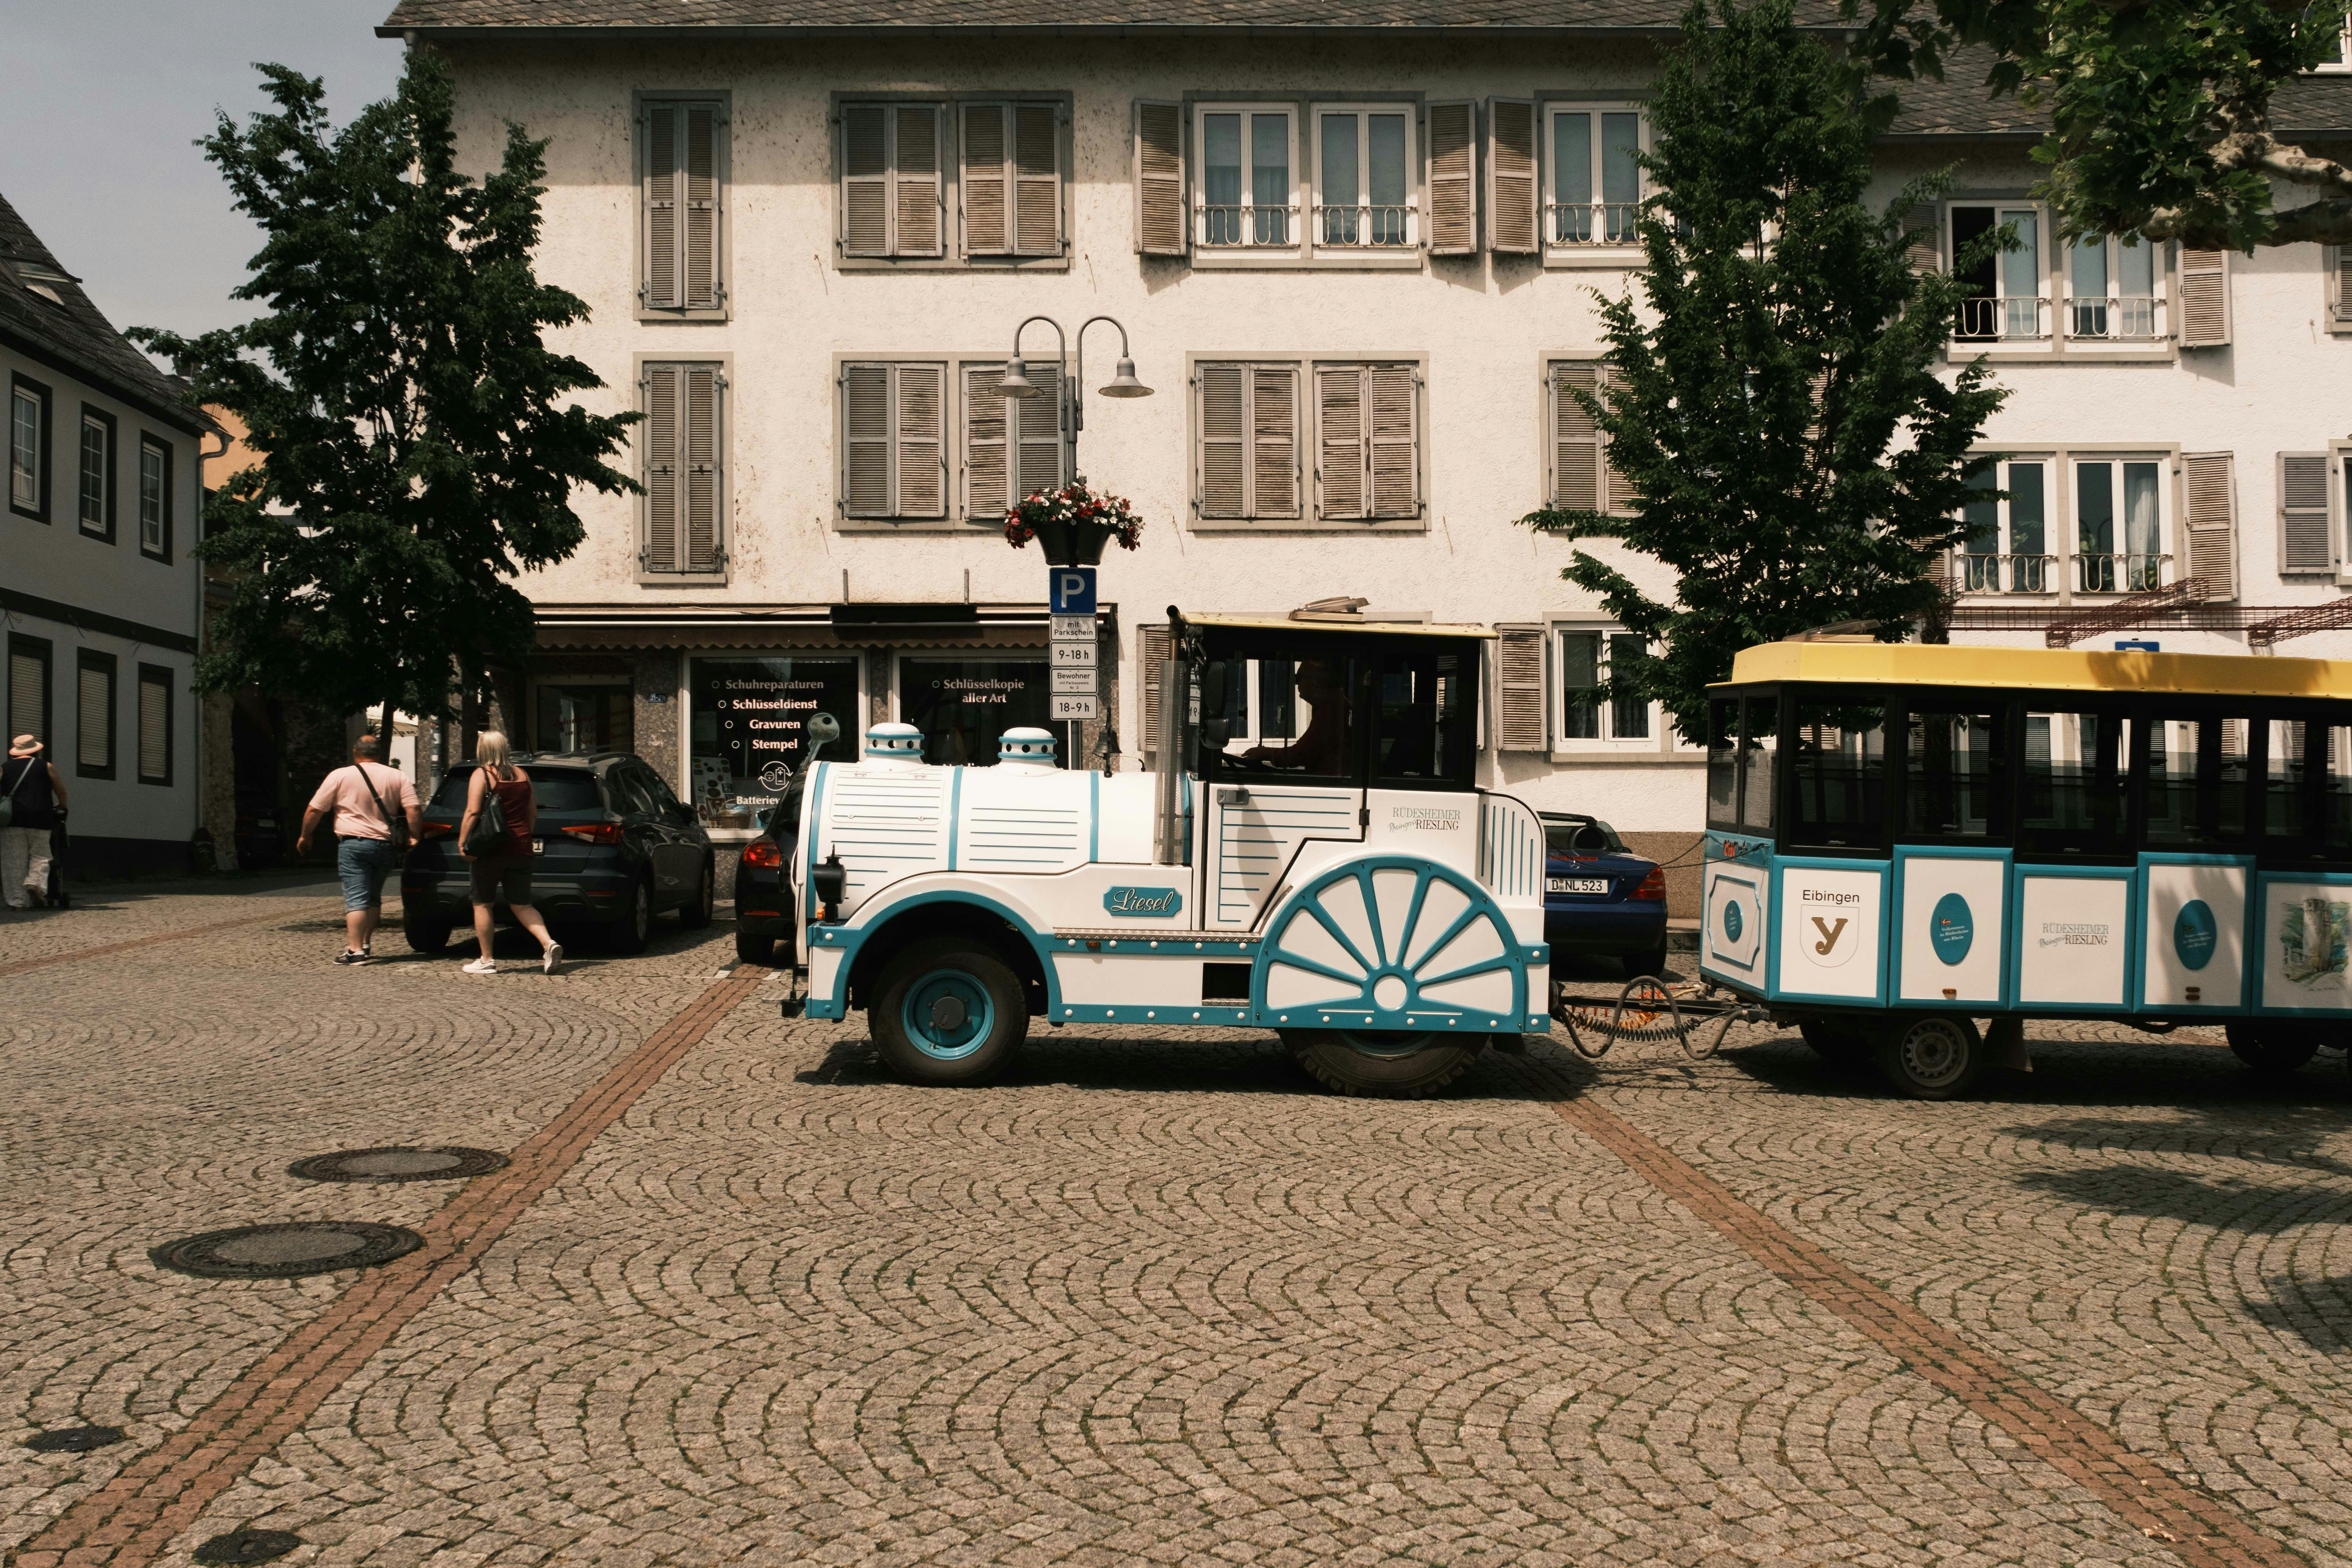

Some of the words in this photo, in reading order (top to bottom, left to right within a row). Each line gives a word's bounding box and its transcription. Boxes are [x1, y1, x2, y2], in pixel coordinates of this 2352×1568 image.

[1061, 574, 1085, 608] P
[1059, 650, 1081, 659] 9-18
[1084, 650, 1089, 659] h
[726, 680, 824, 692] Schuhreparaturen
[944, 679, 1024, 692] Schlüsselkopie
[962, 693, 987, 703] aller
[989, 693, 1007, 703] Art
[732, 699, 818, 709] Schlüsseldienst
[1059, 703, 1082, 712] 18-9
[1085, 703, 1089, 712] h
[749, 719, 800, 729] Gravuren
[753, 738, 798, 752] Stempel
[1393, 807, 1461, 820] RÜDESHEIMER
[1416, 819, 1459, 830] RIESLING
[1552, 880, 1559, 890] D
[1565, 880, 1579, 891] NL
[1582, 880, 1602, 891] 523
[1110, 888, 1174, 912] Liesel
[1803, 890, 1860, 905] Eibingen
[2043, 922, 2109, 935] RÜDESHEIMER
[2064, 935, 2108, 945] RIESLING
